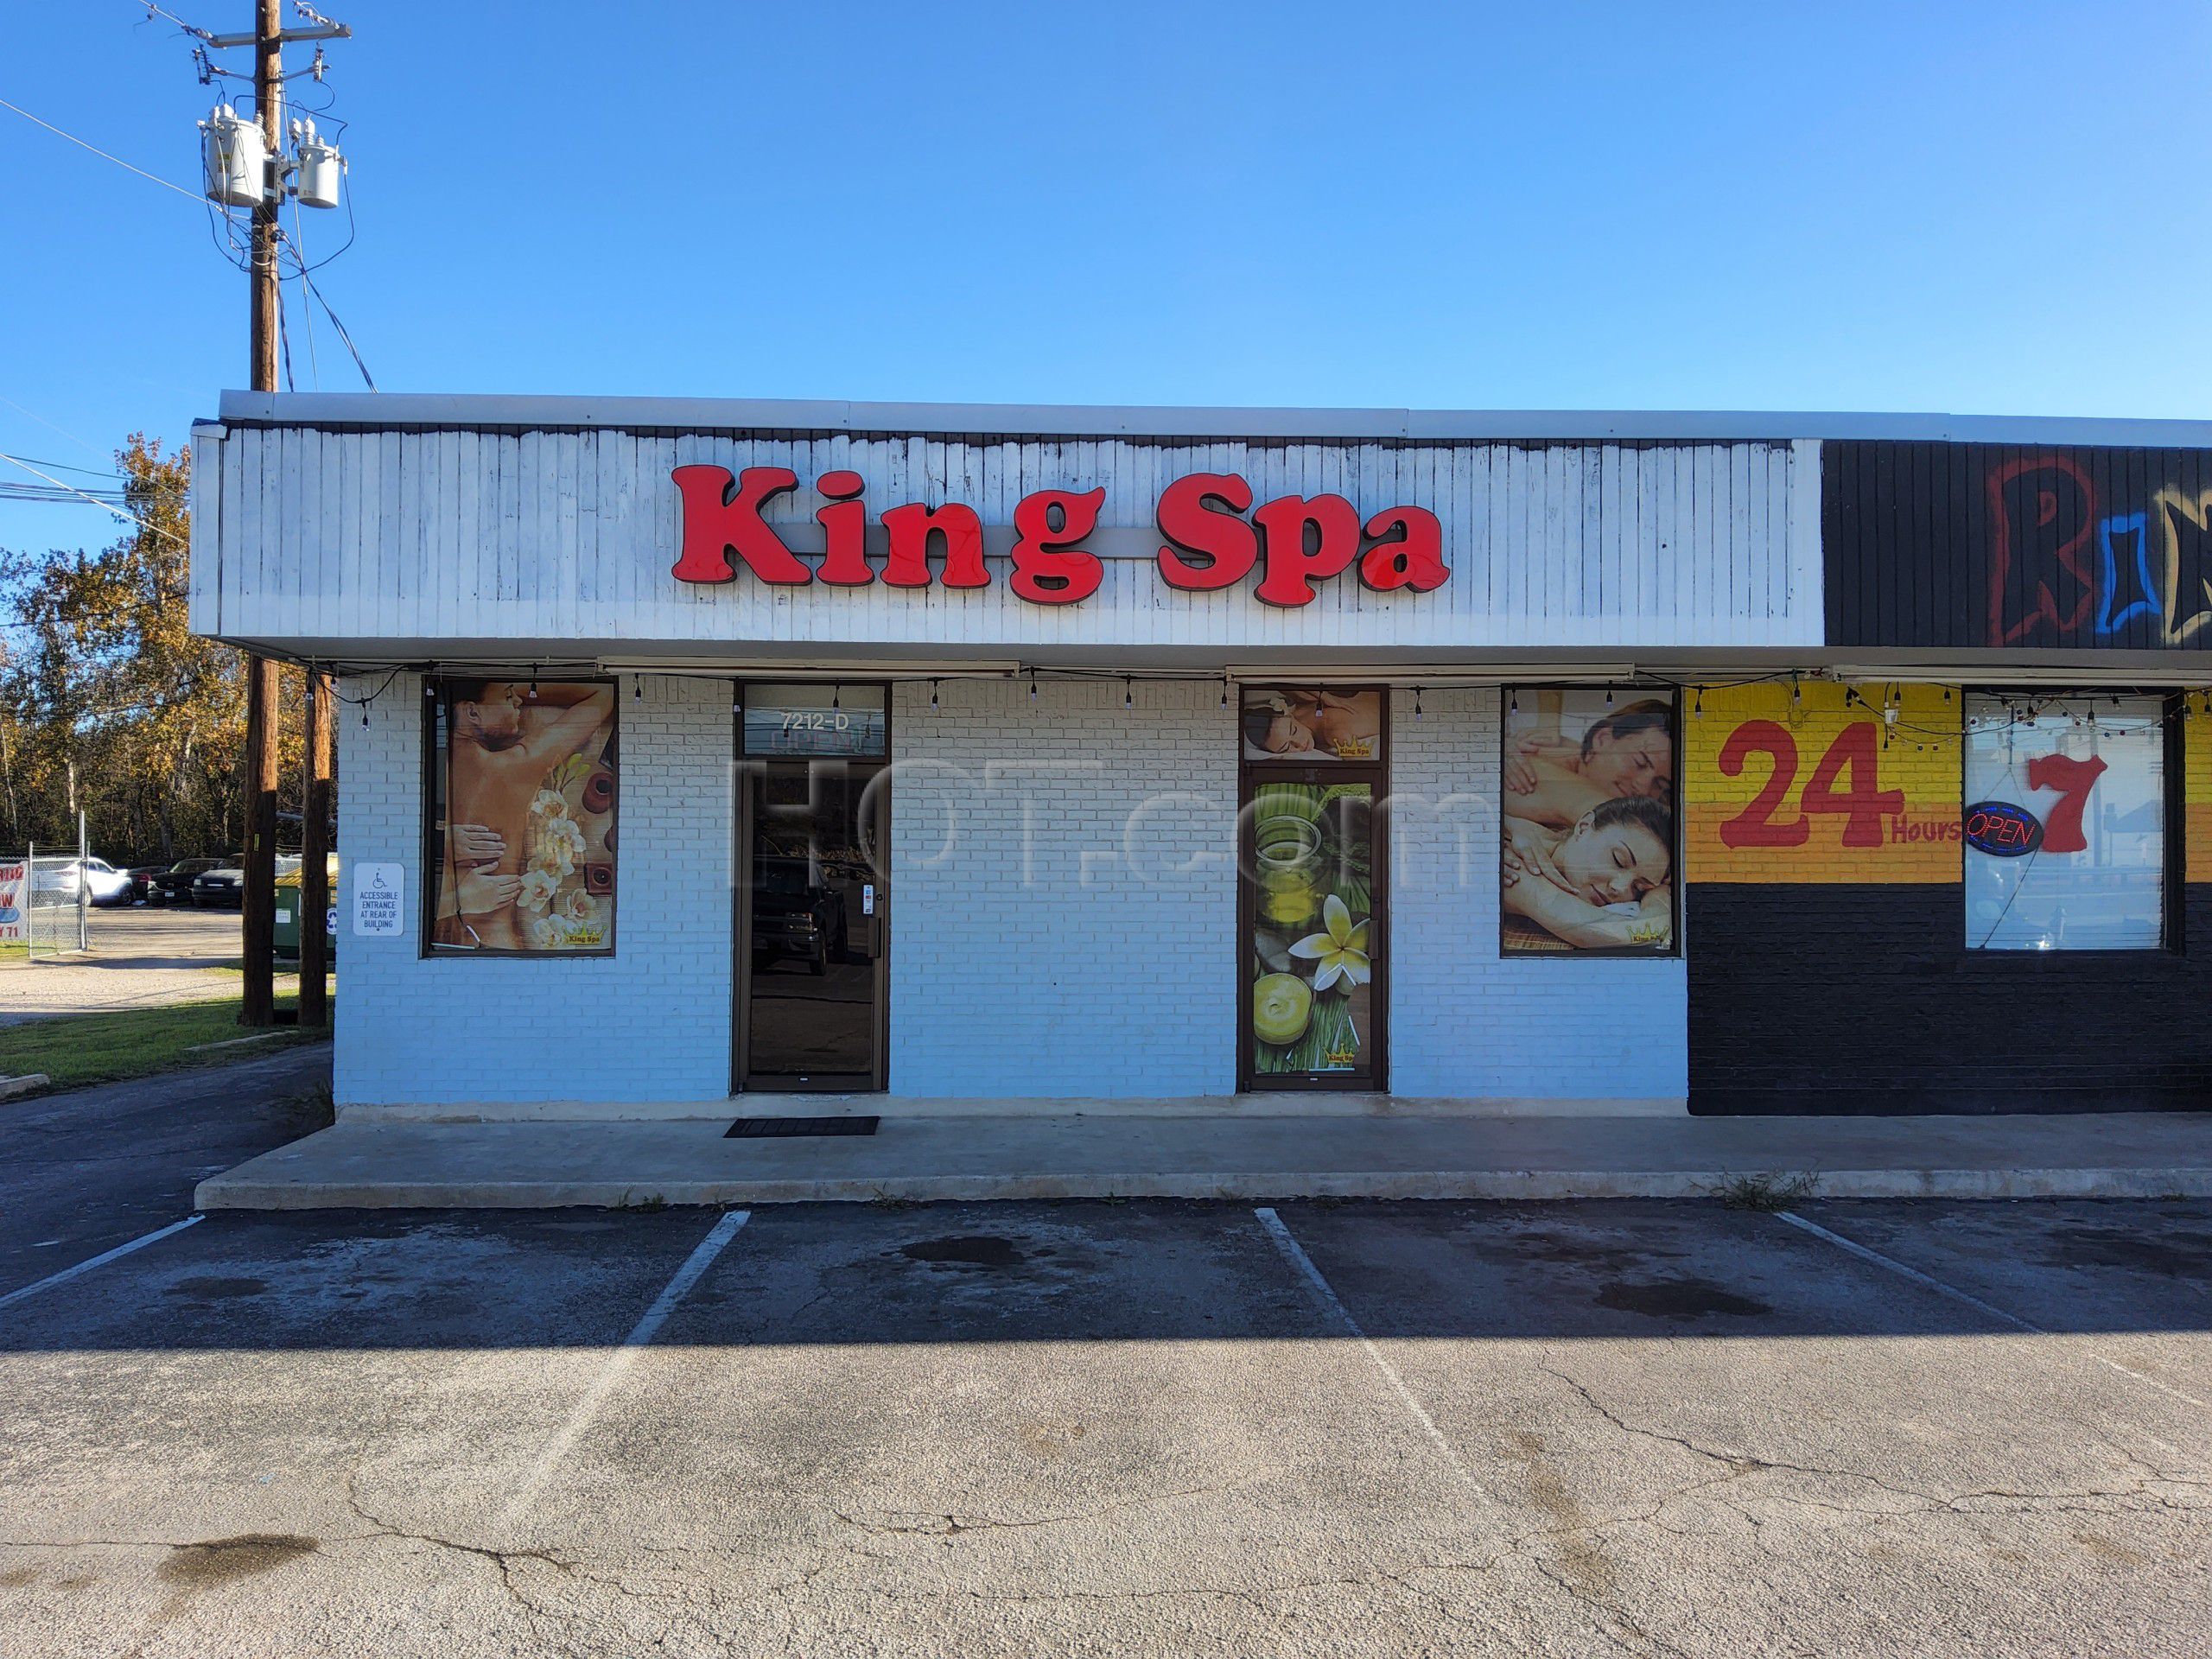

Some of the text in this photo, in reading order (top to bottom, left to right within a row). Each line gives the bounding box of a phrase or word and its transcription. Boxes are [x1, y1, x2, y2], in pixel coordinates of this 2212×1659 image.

[671, 465, 1451, 607] King Spa
[781, 713, 849, 730] 7212-D
[1718, 719, 1962, 849] 24 Hours
[1966, 812, 2037, 846] OPEN
[2028, 753, 2108, 852] 7
